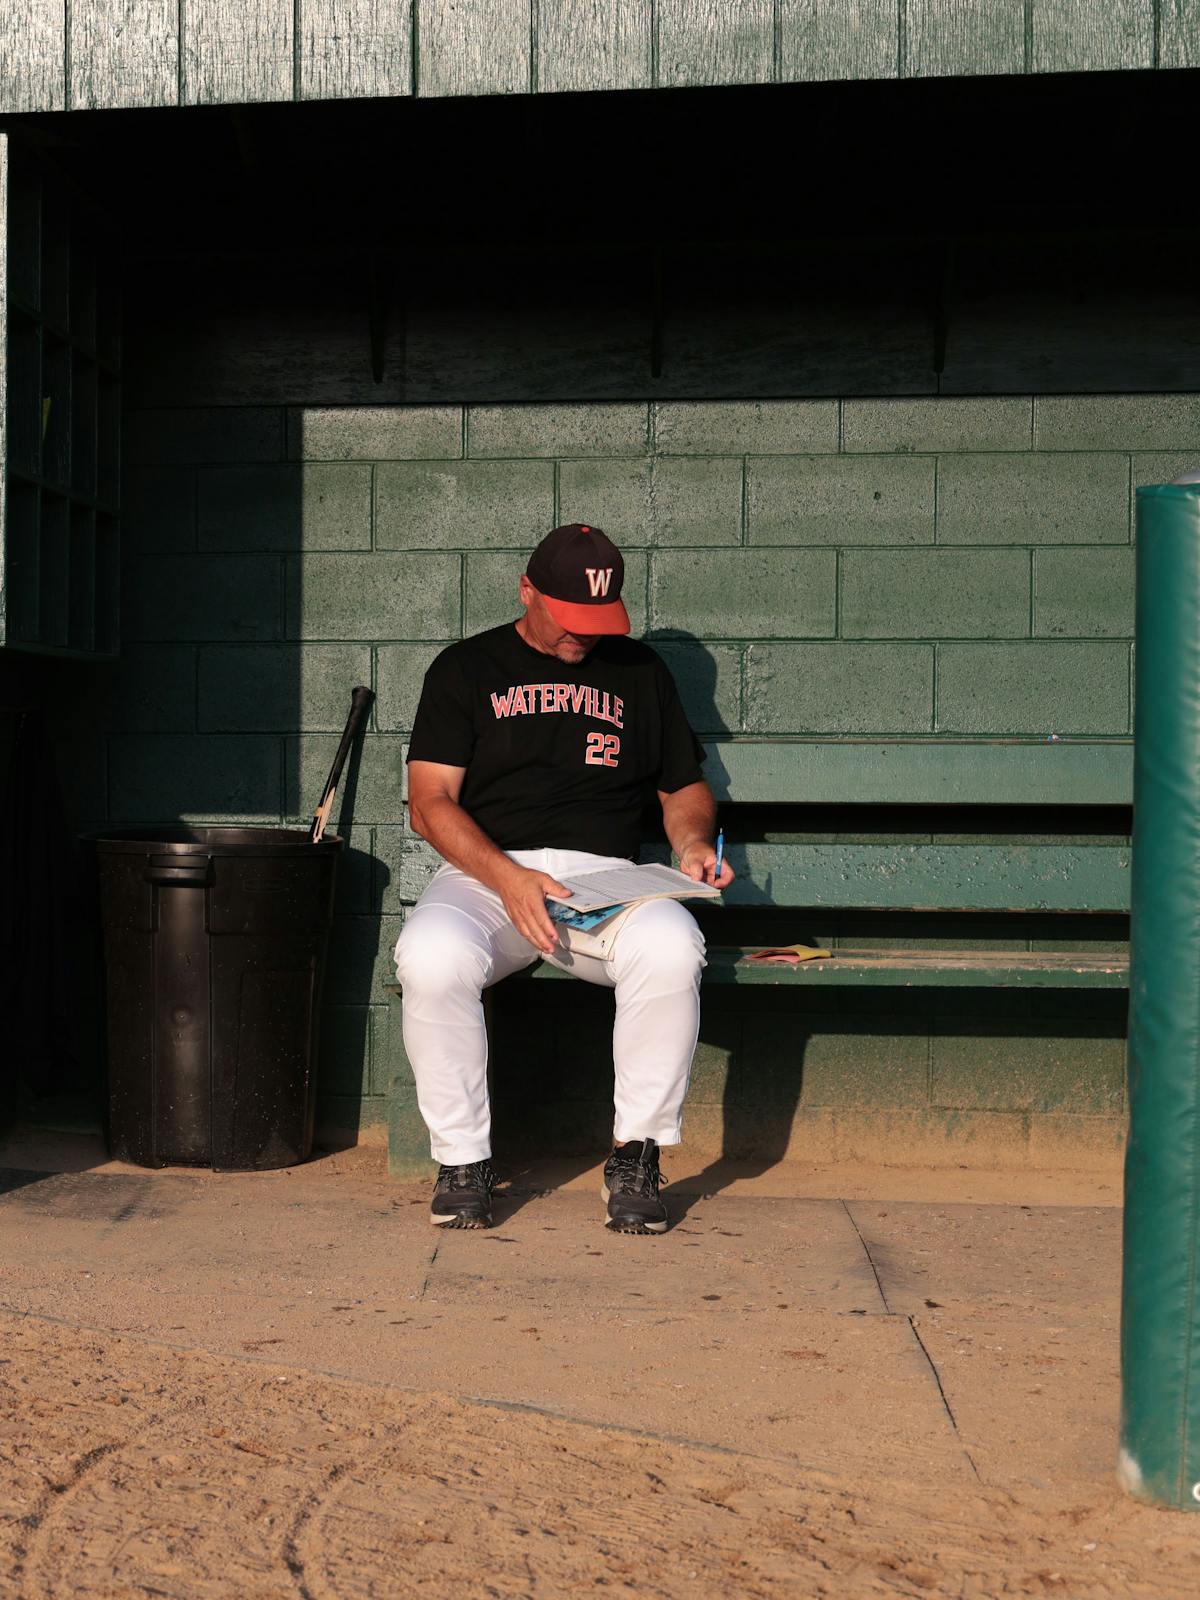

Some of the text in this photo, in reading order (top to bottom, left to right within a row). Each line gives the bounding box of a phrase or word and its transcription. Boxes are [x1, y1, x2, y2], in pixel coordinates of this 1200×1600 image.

[585, 568, 614, 598] W
[490, 683, 624, 729] WATERVILLE
[585, 732, 620, 767] 22
